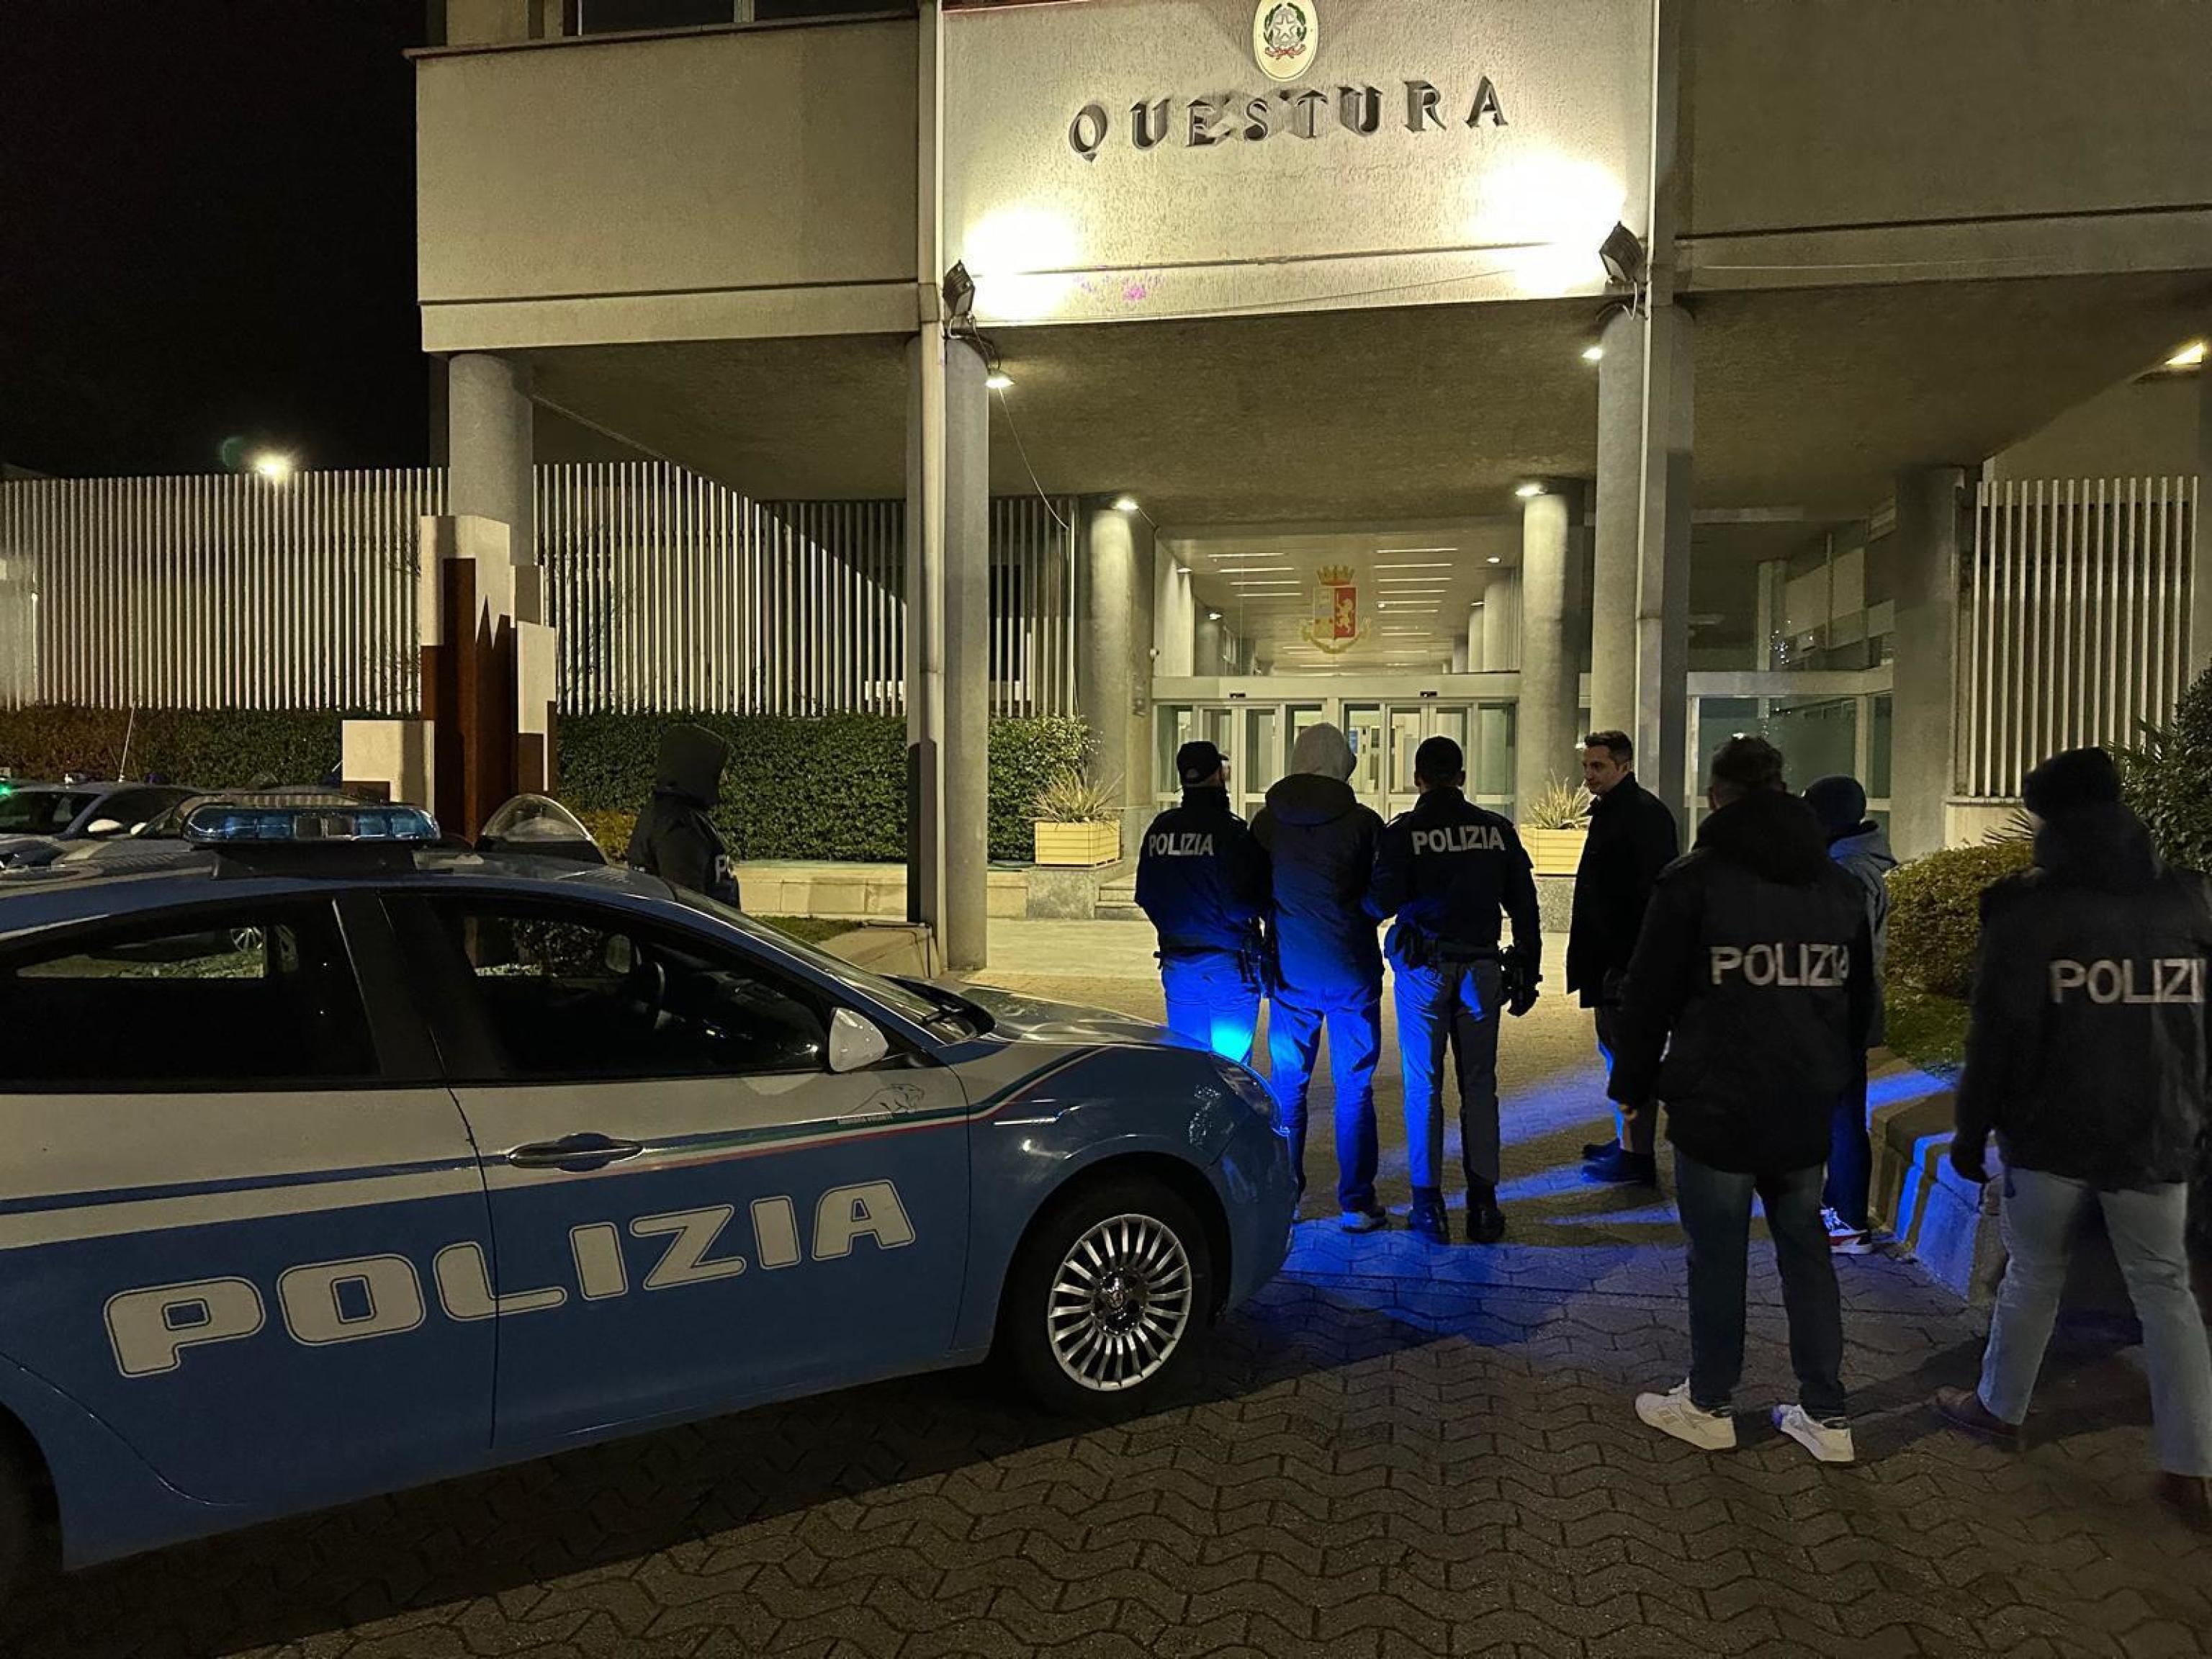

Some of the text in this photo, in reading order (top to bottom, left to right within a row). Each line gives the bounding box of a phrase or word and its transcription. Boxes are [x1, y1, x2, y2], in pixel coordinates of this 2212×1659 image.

[1069, 76, 1509, 163] QUESTURA
[1148, 832, 1215, 858] POLIZIA
[1411, 825, 1506, 855] POLIZIA
[2049, 958, 2207, 1004] POLIZI
[103, 1179, 916, 1377] POLIZIA
